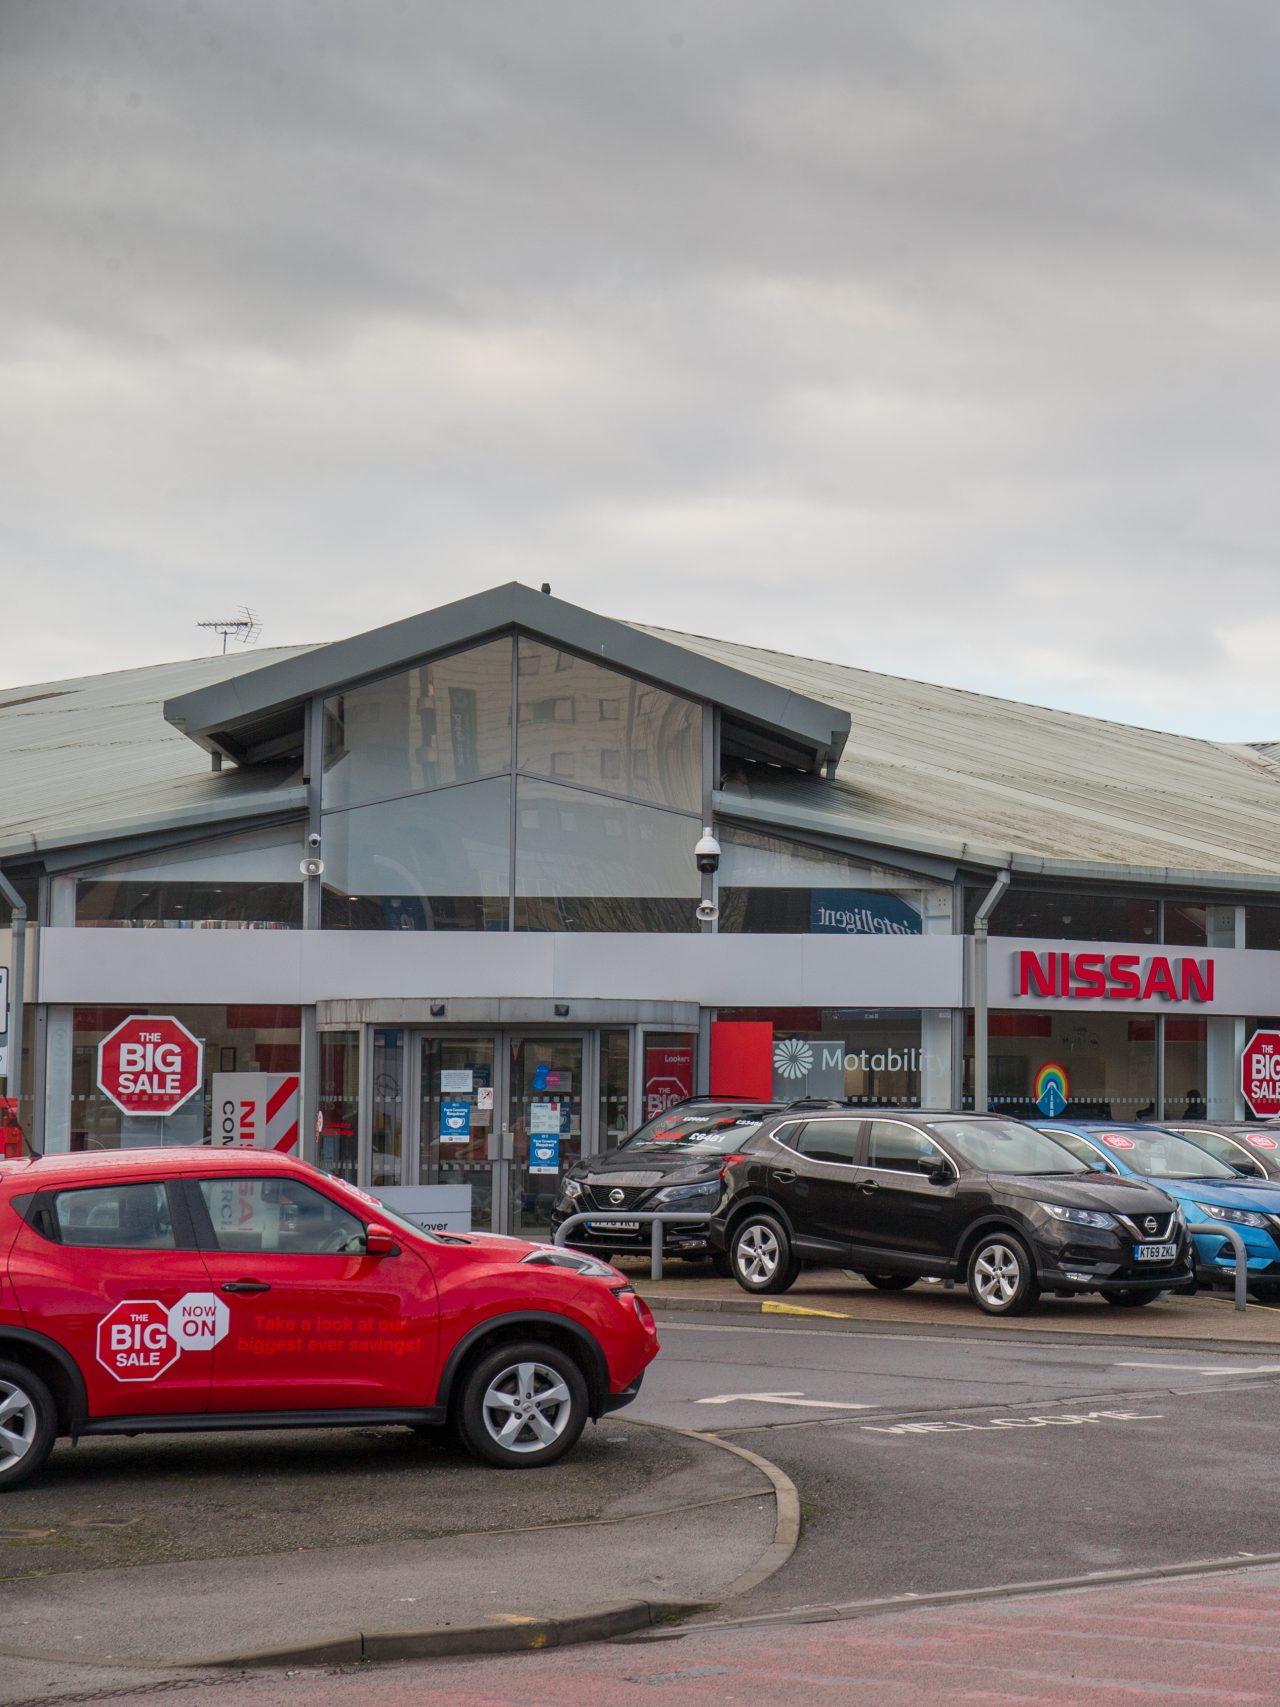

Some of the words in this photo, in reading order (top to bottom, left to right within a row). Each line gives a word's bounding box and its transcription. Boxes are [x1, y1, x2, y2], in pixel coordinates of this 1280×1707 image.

[1017, 950, 1215, 1001] NISSAN
[139, 1032, 161, 1042] THE
[119, 1043, 182, 1072] BIG
[1261, 1045, 1273, 1054] THE
[821, 1047, 948, 1076] Motability
[118, 1074, 181, 1094] SALE
[1140, 1247, 1160, 1258] KT69
[1161, 1246, 1175, 1257] ZKL
[130, 1314, 149, 1322] THE
[182, 1306, 217, 1317] NOW
[183, 1320, 215, 1336] ON
[255, 1316, 296, 1331] Take
[301, 1319, 311, 1331] a
[317, 1317, 352, 1331] look
[358, 1317, 372, 1331] at
[379, 1320, 406, 1331] our
[111, 1323, 167, 1350] BIG
[237, 1337, 302, 1355] biggest
[308, 1340, 344, 1351] ever
[350, 1337, 421, 1355] savings!
[116, 1352, 160, 1367] SALE
[860, 1410, 1165, 1434] WELCOME
